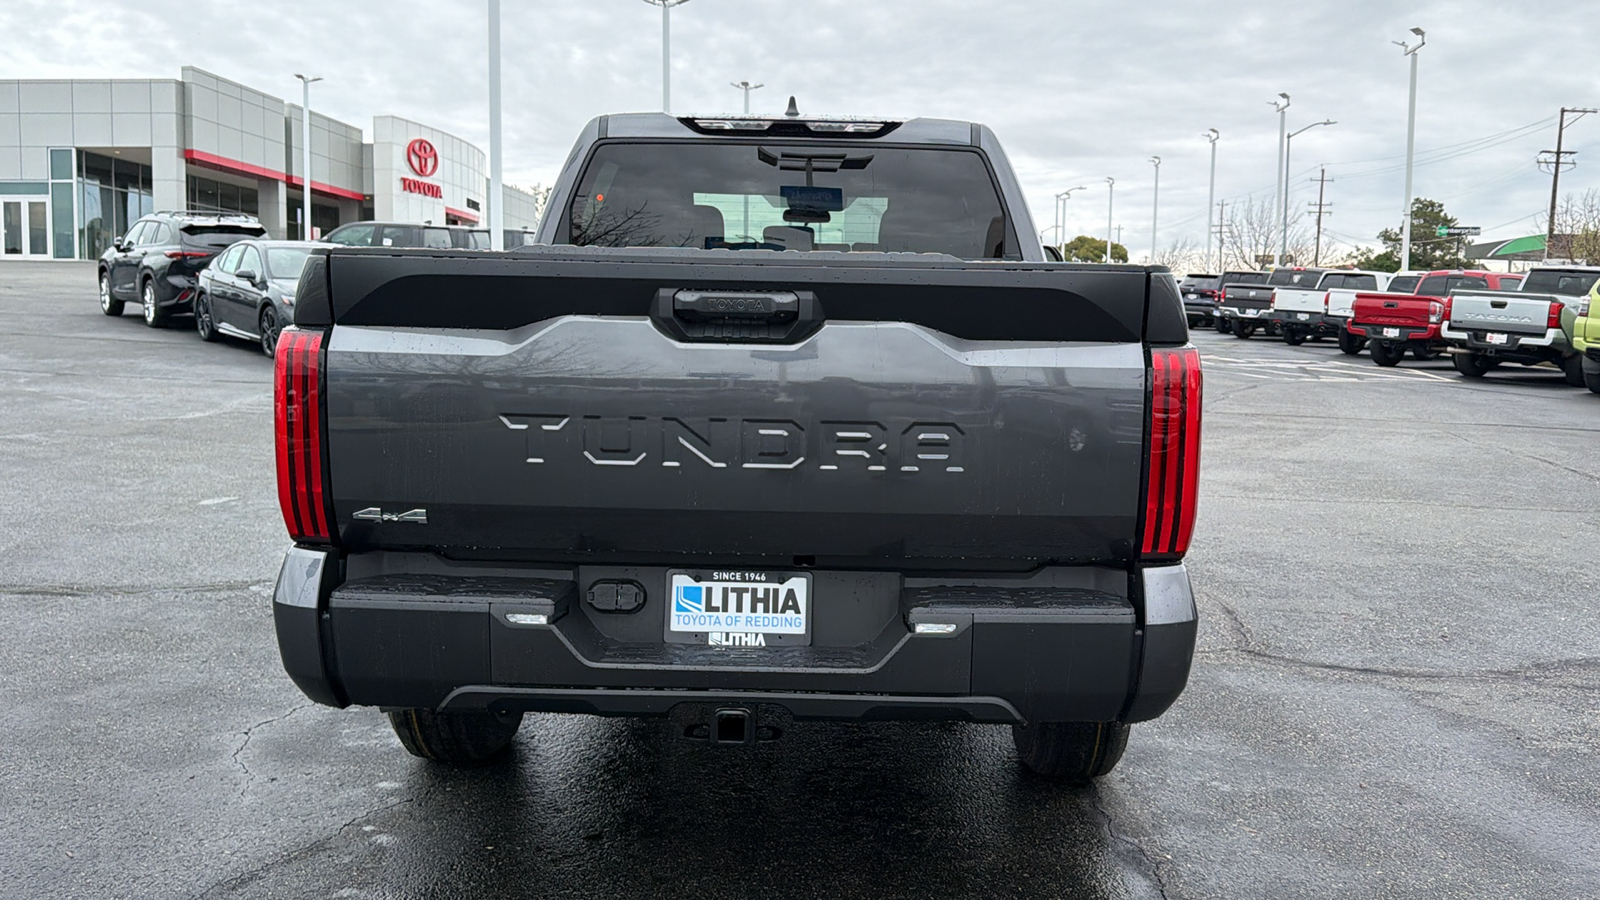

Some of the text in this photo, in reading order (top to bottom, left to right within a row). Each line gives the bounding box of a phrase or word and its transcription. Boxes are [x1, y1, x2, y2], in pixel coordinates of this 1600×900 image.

[400, 177, 443, 199] TOYOTA
[708, 299, 764, 311] TOYOTA
[1465, 313, 1532, 323] TACOMA
[499, 413, 966, 474] TUNDRA
[713, 572, 766, 581] SINCE 1946
[705, 586, 801, 615] LITHIA
[675, 614, 802, 628] TOYOTA OF REDDING
[721, 632, 766, 647] LITHIA
